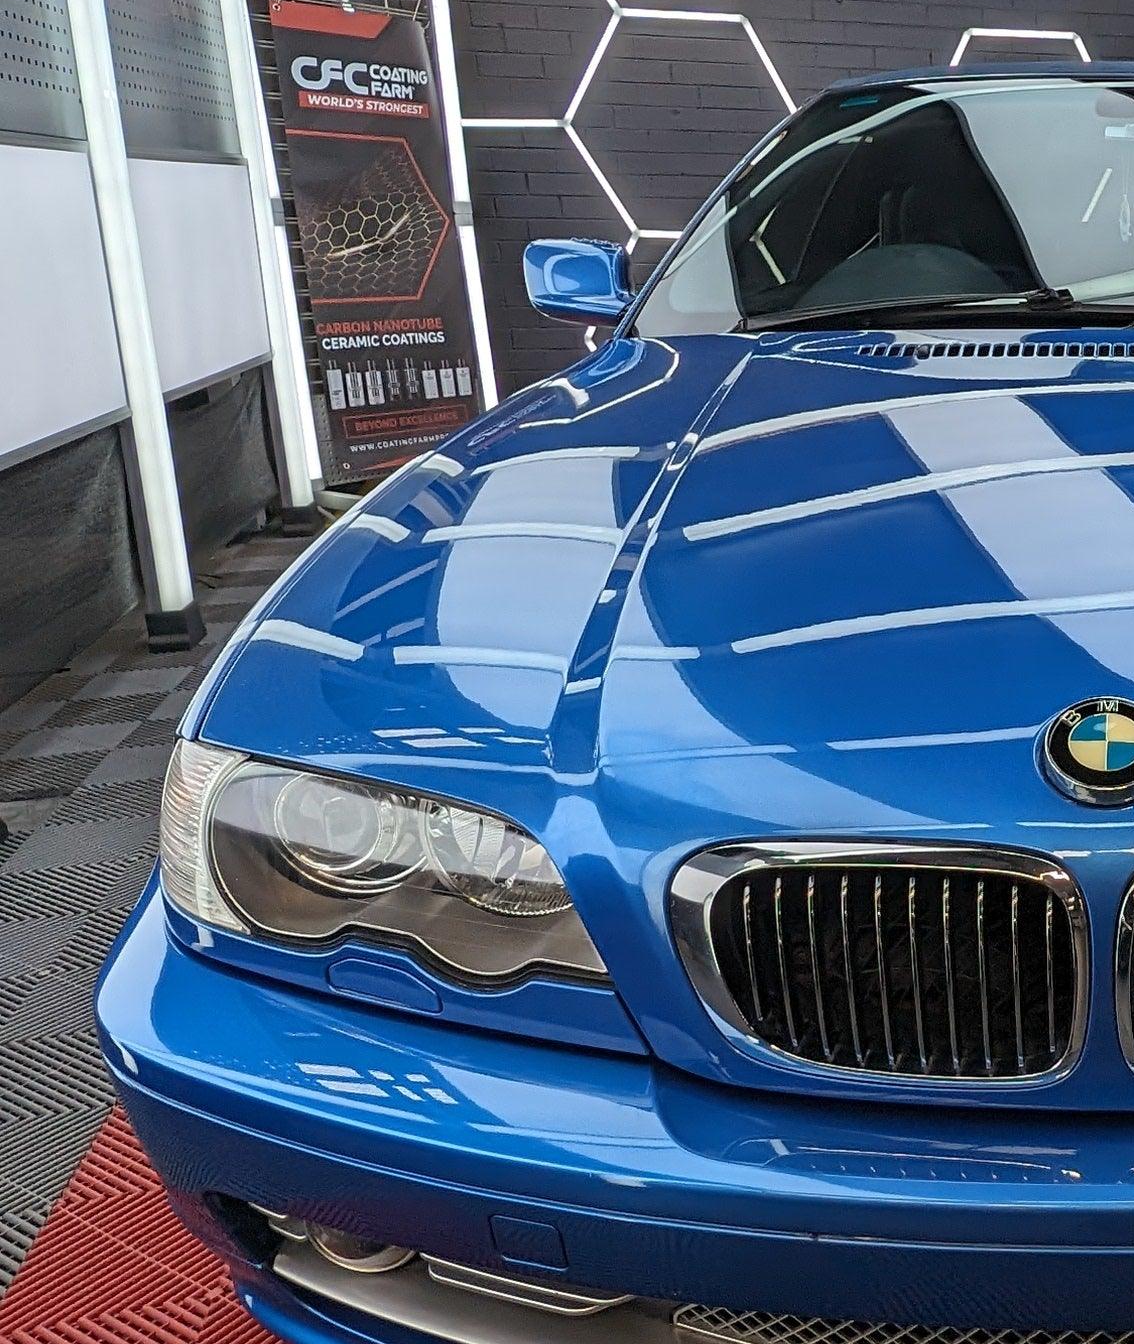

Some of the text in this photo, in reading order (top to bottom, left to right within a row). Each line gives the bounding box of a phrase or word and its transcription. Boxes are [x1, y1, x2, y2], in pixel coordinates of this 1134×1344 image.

[291, 56, 428, 95] CFC COATING
[371, 81, 413, 99] FARM
[307, 94, 423, 114] WORLD'S STRONGEST
[316, 317, 443, 335] CARBON NANOTUBE
[322, 331, 445, 350] CERAMIC COATINGS
